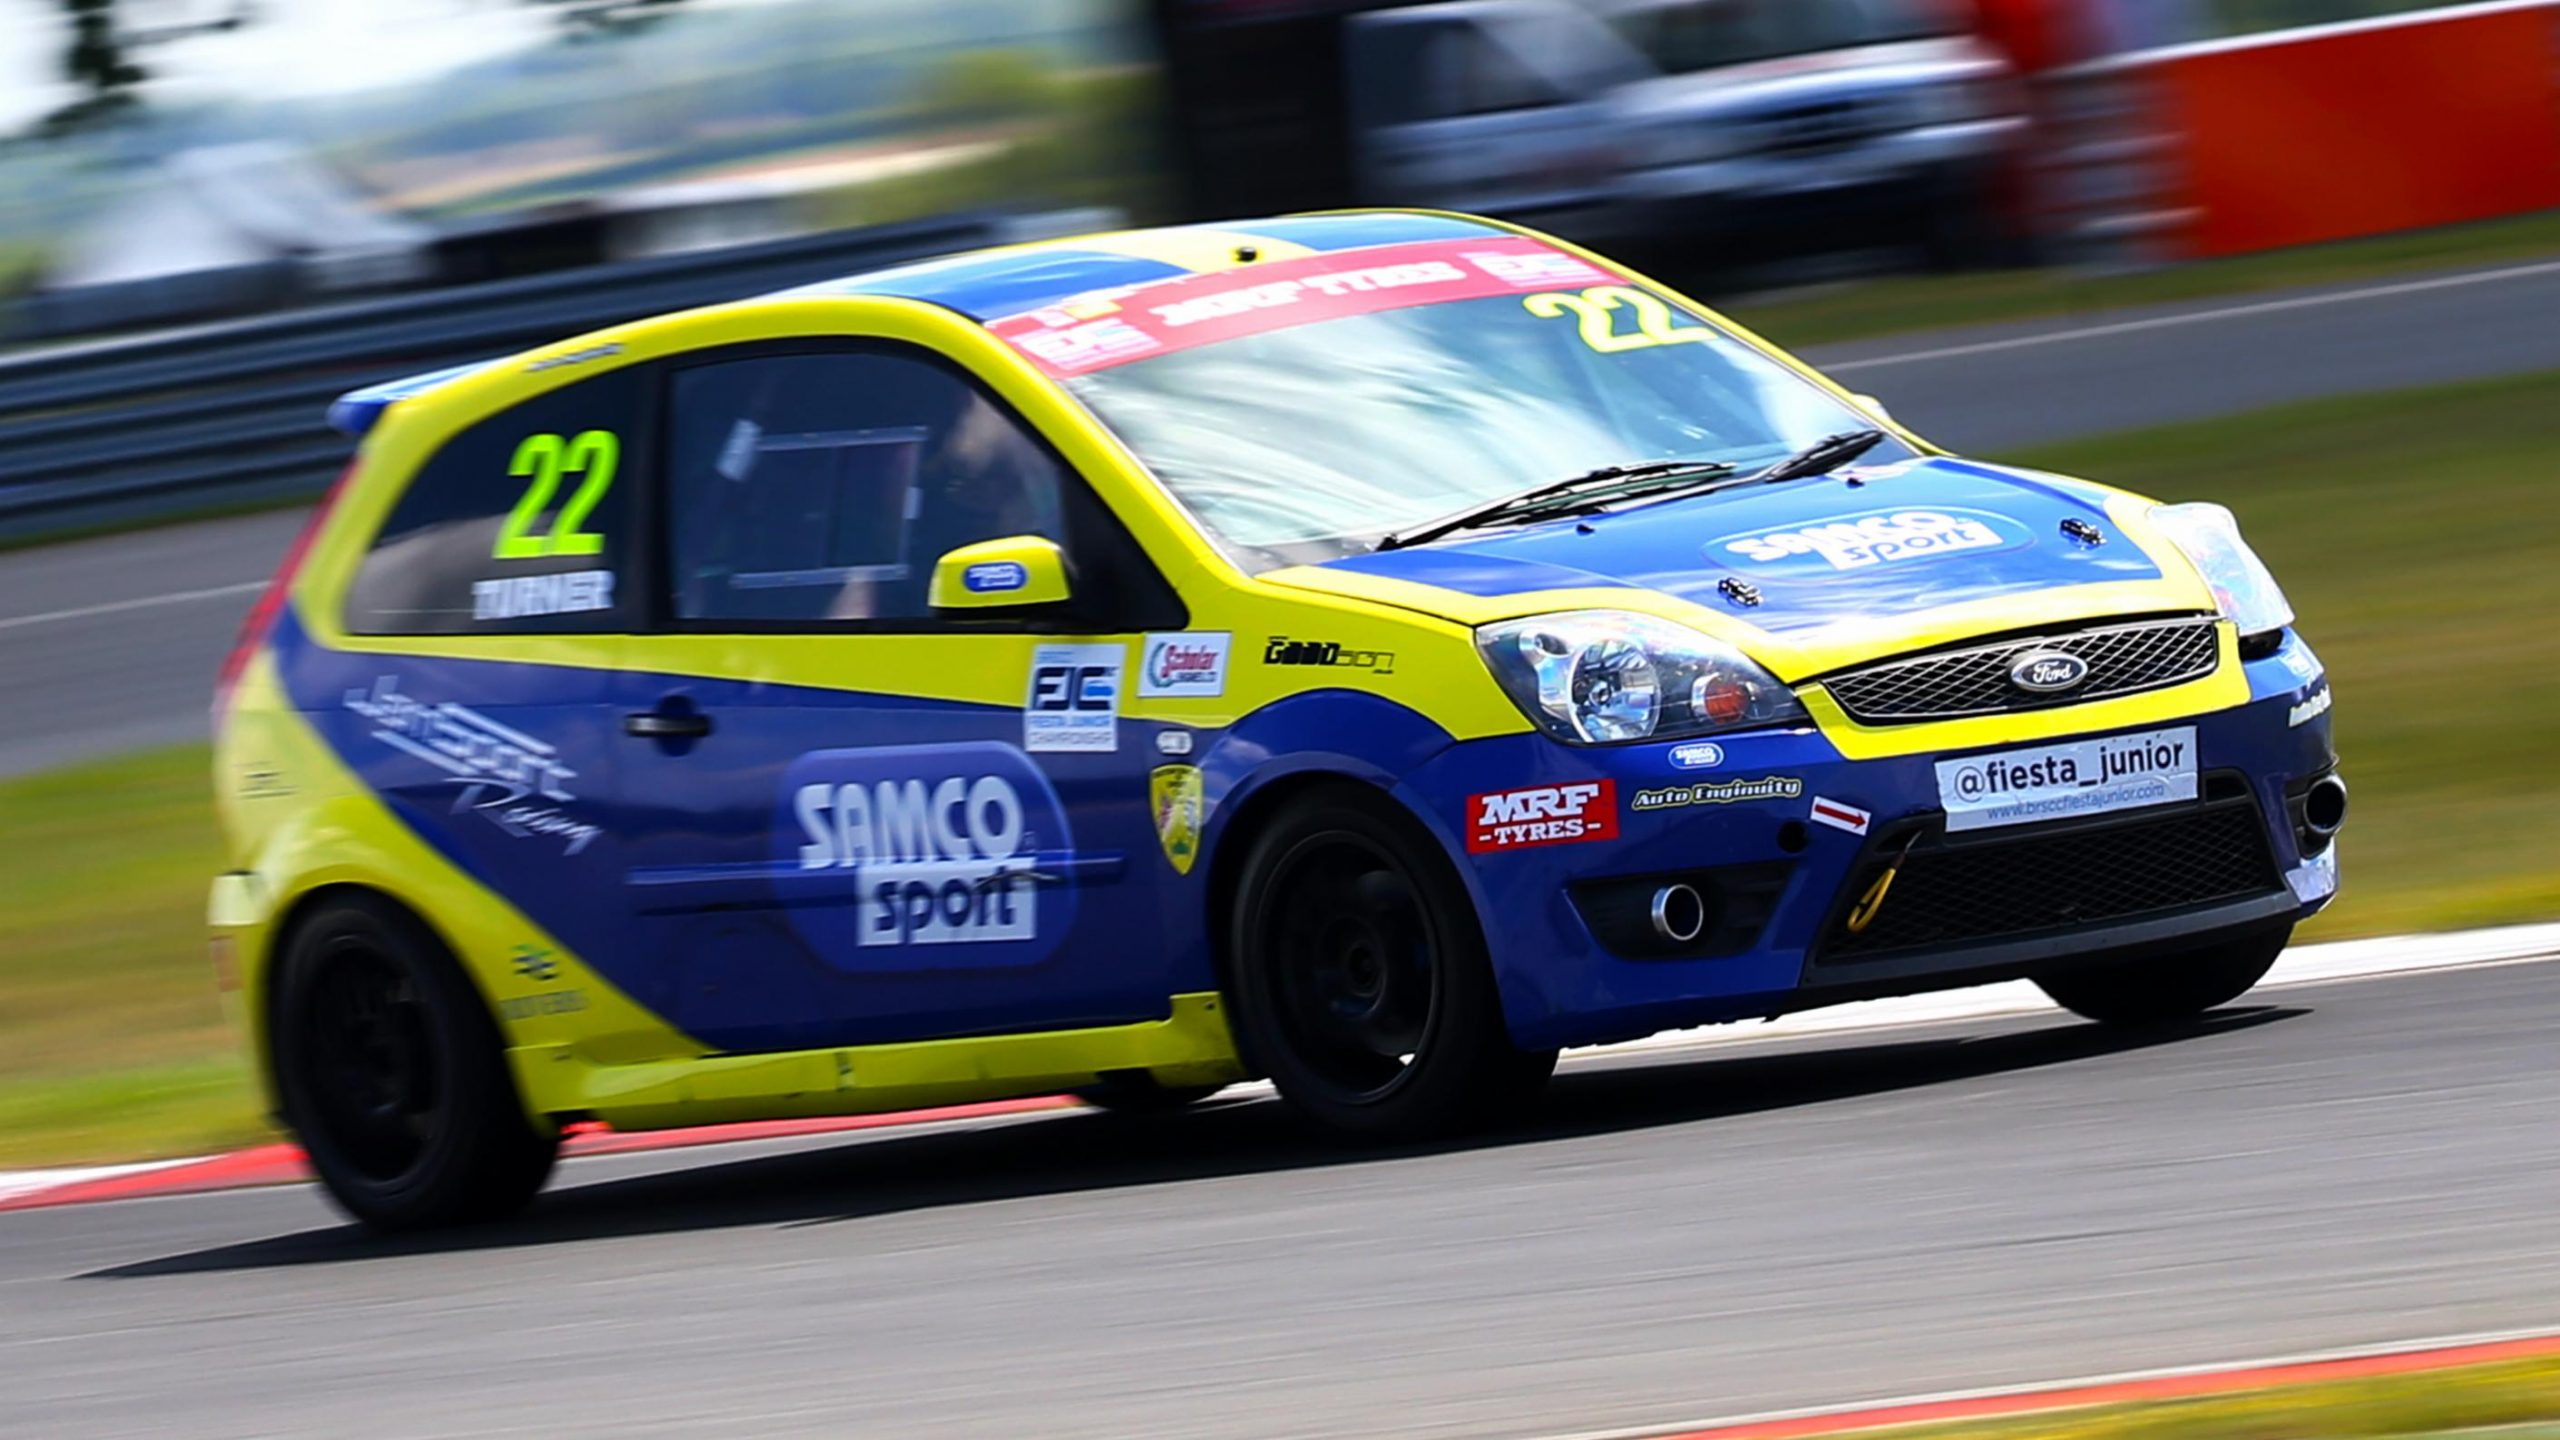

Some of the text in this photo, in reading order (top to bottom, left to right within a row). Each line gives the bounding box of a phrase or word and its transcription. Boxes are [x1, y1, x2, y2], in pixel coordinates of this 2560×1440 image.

[1522, 286, 1719, 353] 22
[493, 430, 620, 558] 22
[2032, 661, 2074, 684] Ford
[1635, 779, 1800, 807] Auto Enginuity
[1955, 739, 2184, 802] @fiesta_junior
[795, 775, 1023, 869] SAMCO
[1478, 783, 1599, 826] MRF
[872, 865, 1019, 945] sport
